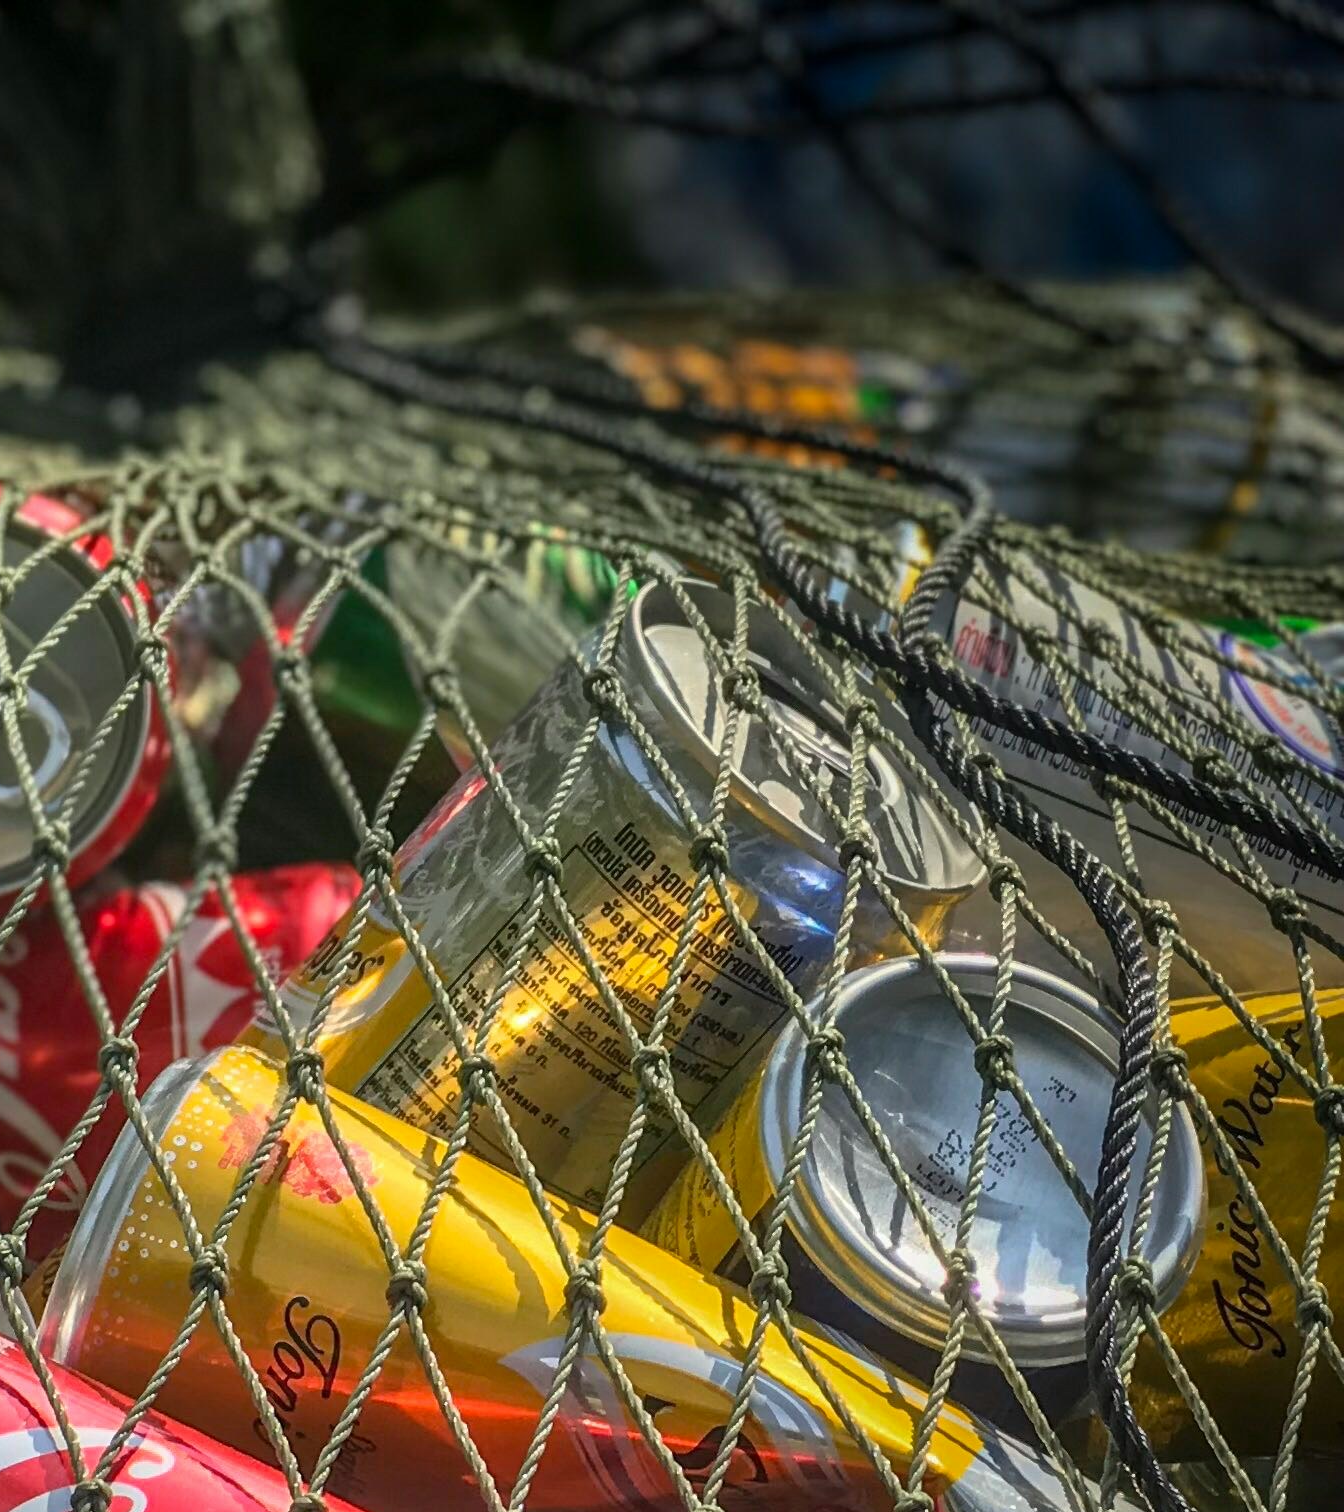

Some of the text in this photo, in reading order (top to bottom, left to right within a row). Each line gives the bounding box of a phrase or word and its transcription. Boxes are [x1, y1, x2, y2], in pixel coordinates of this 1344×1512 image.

[590, 894, 736, 1017] ข้อมูลโภชาการ
[572, 1019, 599, 1044] 120
